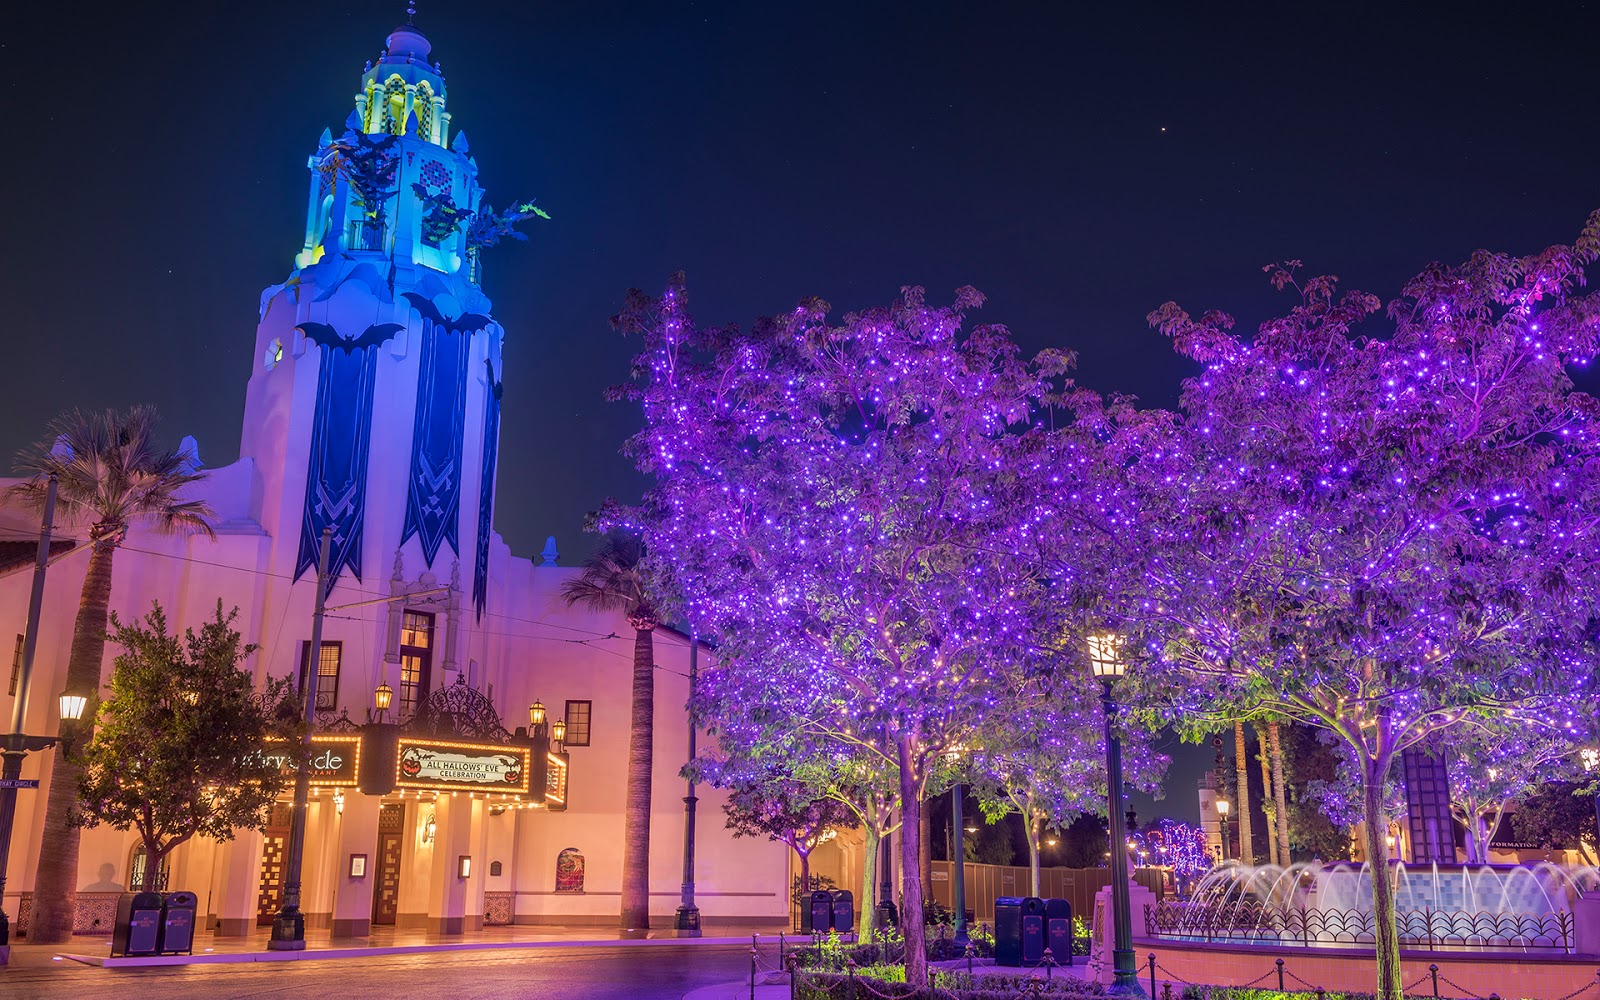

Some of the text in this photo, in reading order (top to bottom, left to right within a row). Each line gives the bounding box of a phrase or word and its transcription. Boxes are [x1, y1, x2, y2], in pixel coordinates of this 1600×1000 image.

[427, 760, 441, 769] ALL
[443, 762, 483, 771] HALLOWS'
[440, 770, 487, 779] CELEBRATION
